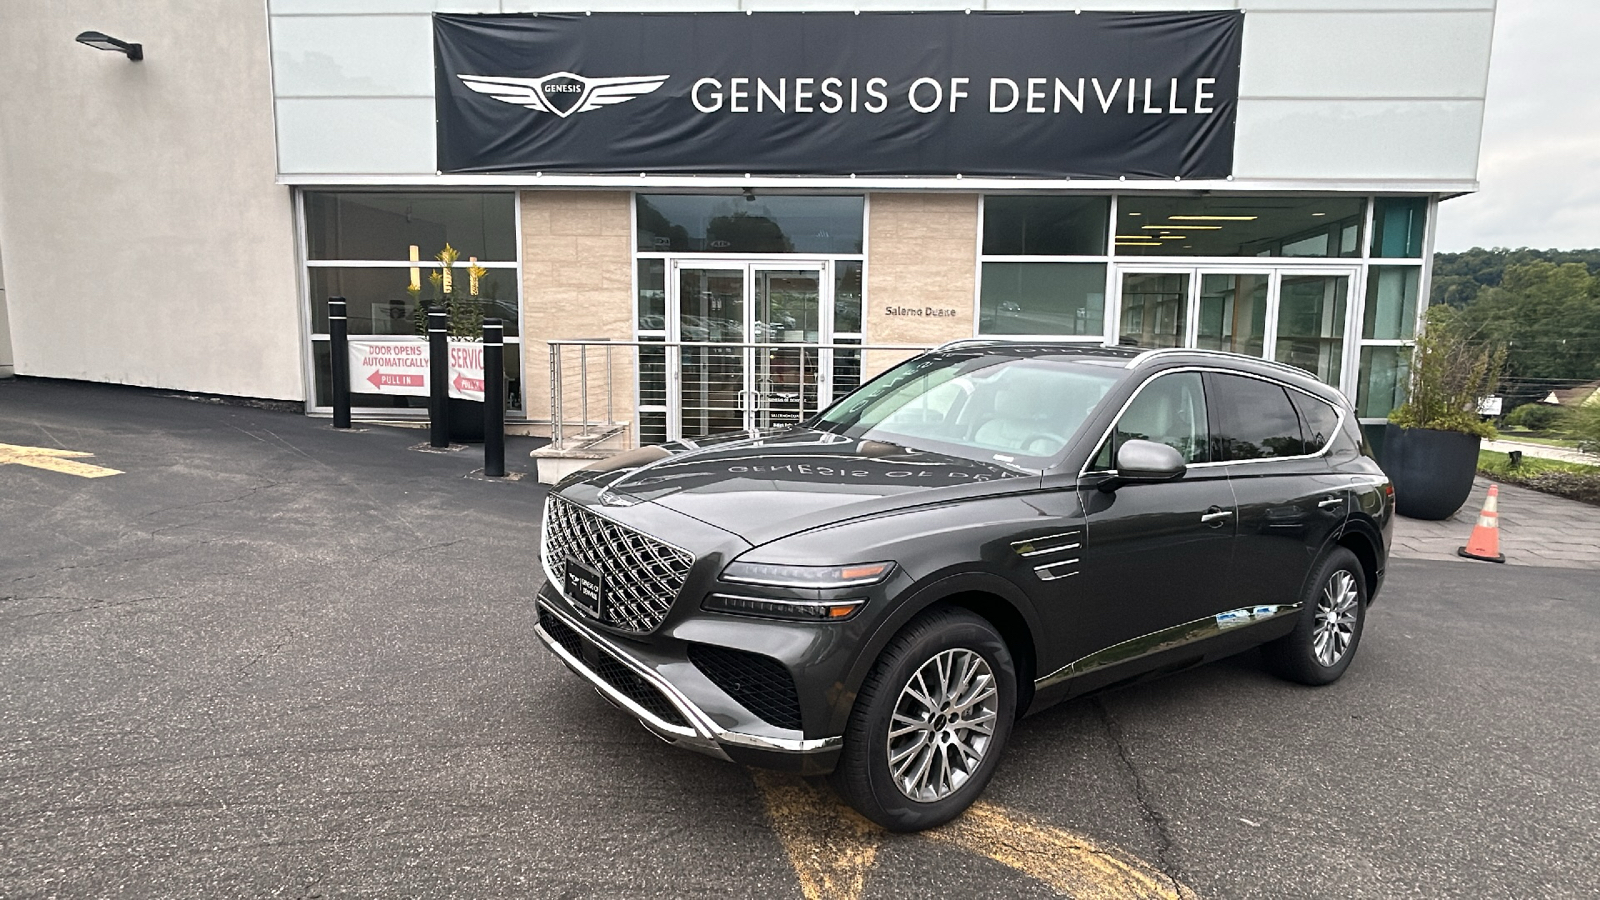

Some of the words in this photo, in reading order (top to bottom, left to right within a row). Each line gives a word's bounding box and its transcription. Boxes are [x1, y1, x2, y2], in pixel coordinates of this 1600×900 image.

[544, 84, 581, 93] GENESIS
[691, 77, 888, 114] GENESIS
[908, 77, 970, 114] OF
[989, 77, 1216, 114] DENVILLE
[885, 306, 922, 317] Salerno
[369, 345, 392, 355] DOOR
[394, 346, 422, 355] OPENS
[362, 357, 429, 368] AUTOMATICALLY
[381, 375, 400, 384] PULL
[403, 376, 411, 385] IN
